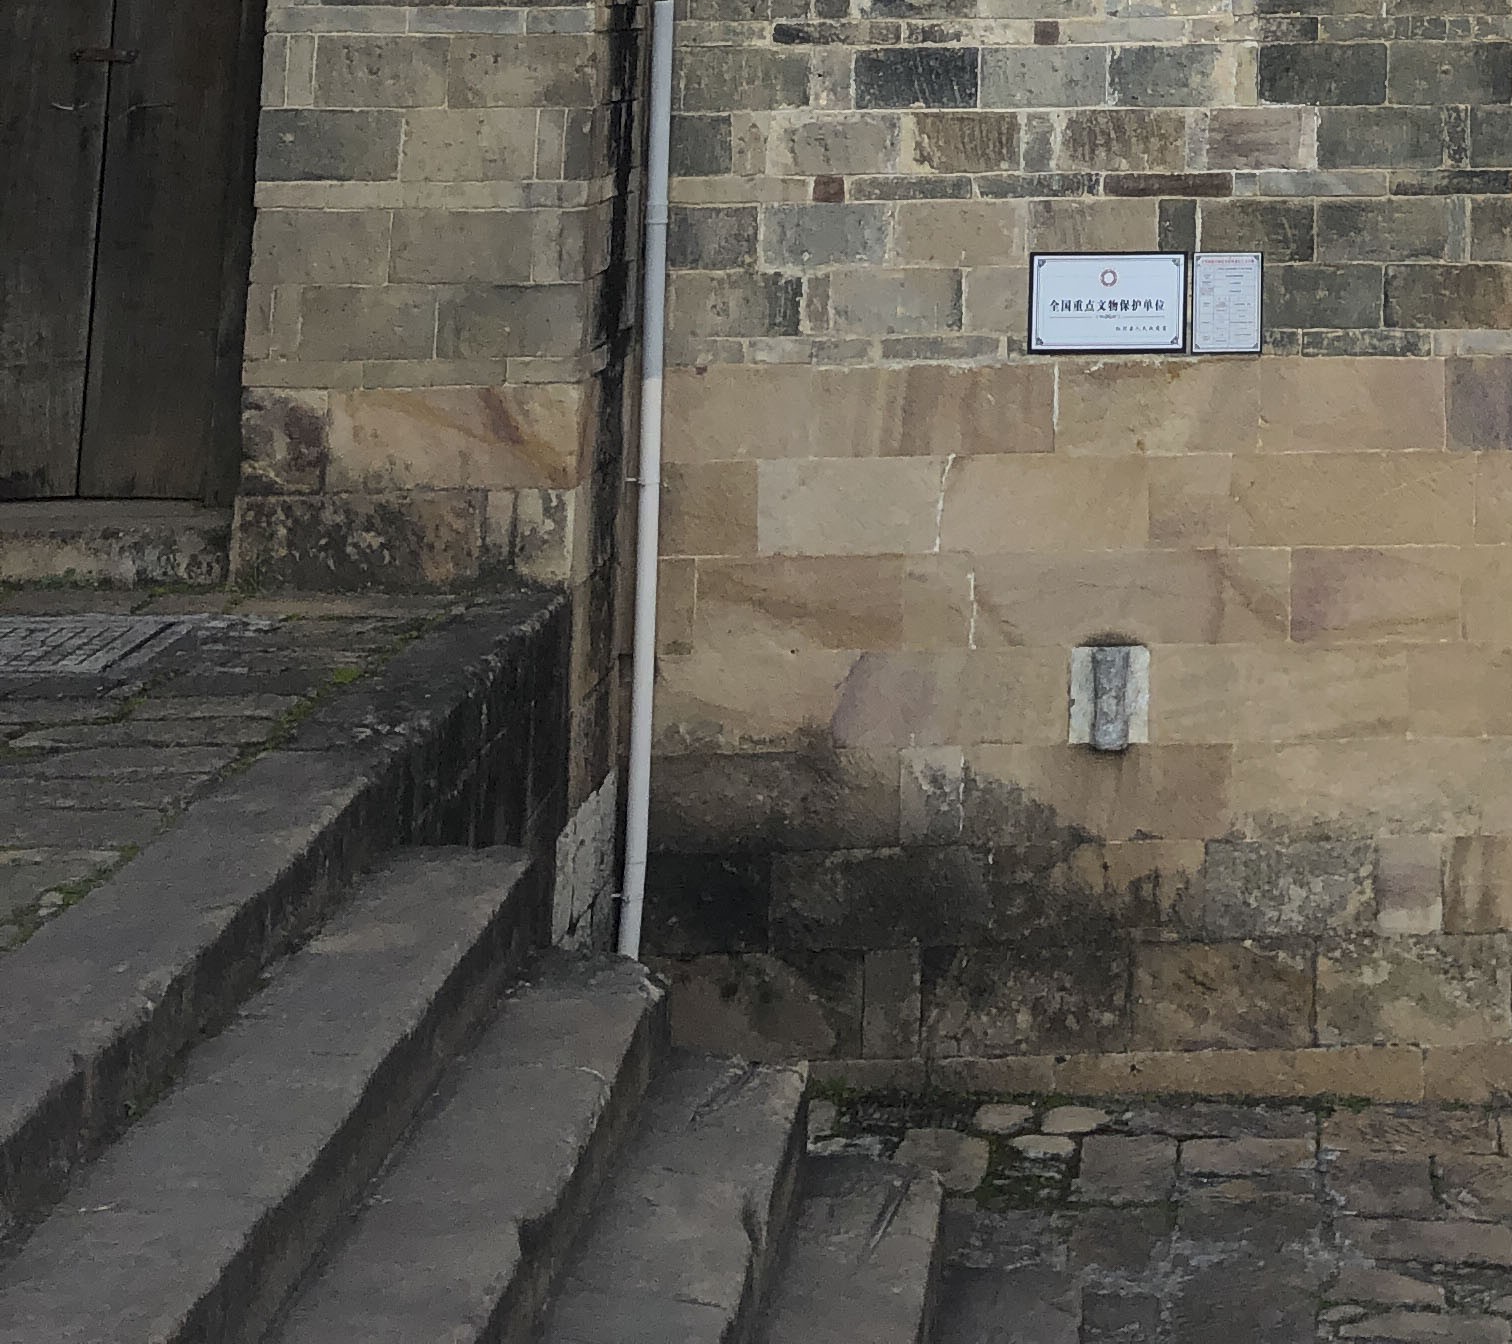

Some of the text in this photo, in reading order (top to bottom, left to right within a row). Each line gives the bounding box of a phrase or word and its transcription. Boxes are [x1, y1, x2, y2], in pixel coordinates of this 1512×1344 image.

[1049, 298, 1165, 312] 全国重点文物保护单位
